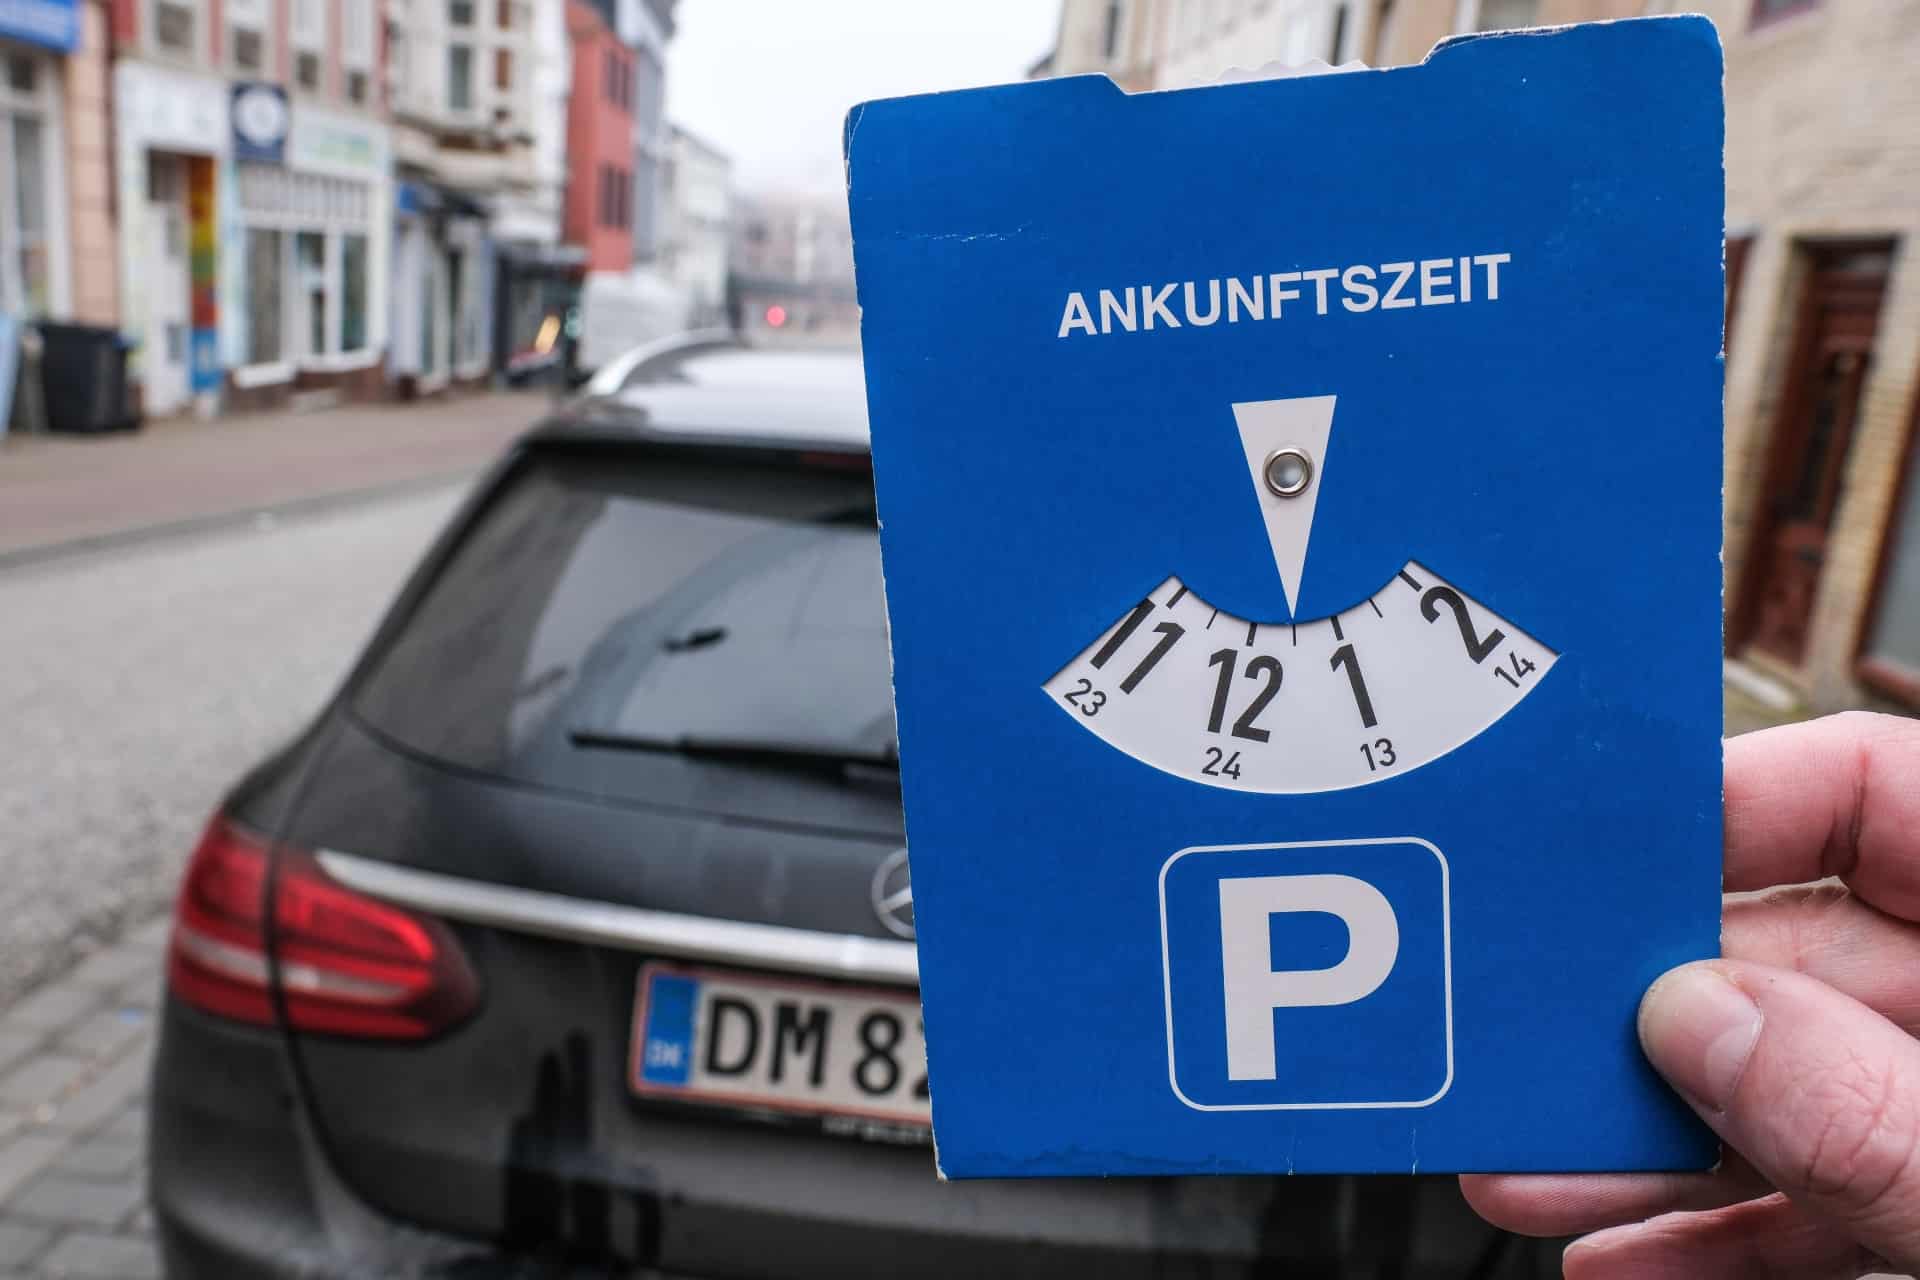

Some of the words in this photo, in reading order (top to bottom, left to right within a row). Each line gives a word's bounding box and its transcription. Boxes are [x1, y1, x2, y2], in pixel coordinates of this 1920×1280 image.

[1057, 253, 1512, 338] ANKUNFTSZEIT
[1063, 678, 1108, 717] 23
[1201, 747, 1242, 780] 24
[1360, 738, 1397, 771] 13
[1494, 651, 1537, 689] 14
[1090, 598, 1186, 695] 11
[1207, 648, 1284, 743] 12
[1330, 643, 1378, 729] 1
[1420, 586, 1506, 665] 2
[704, 995, 831, 1088] DM
[1219, 874, 1400, 1081] P
